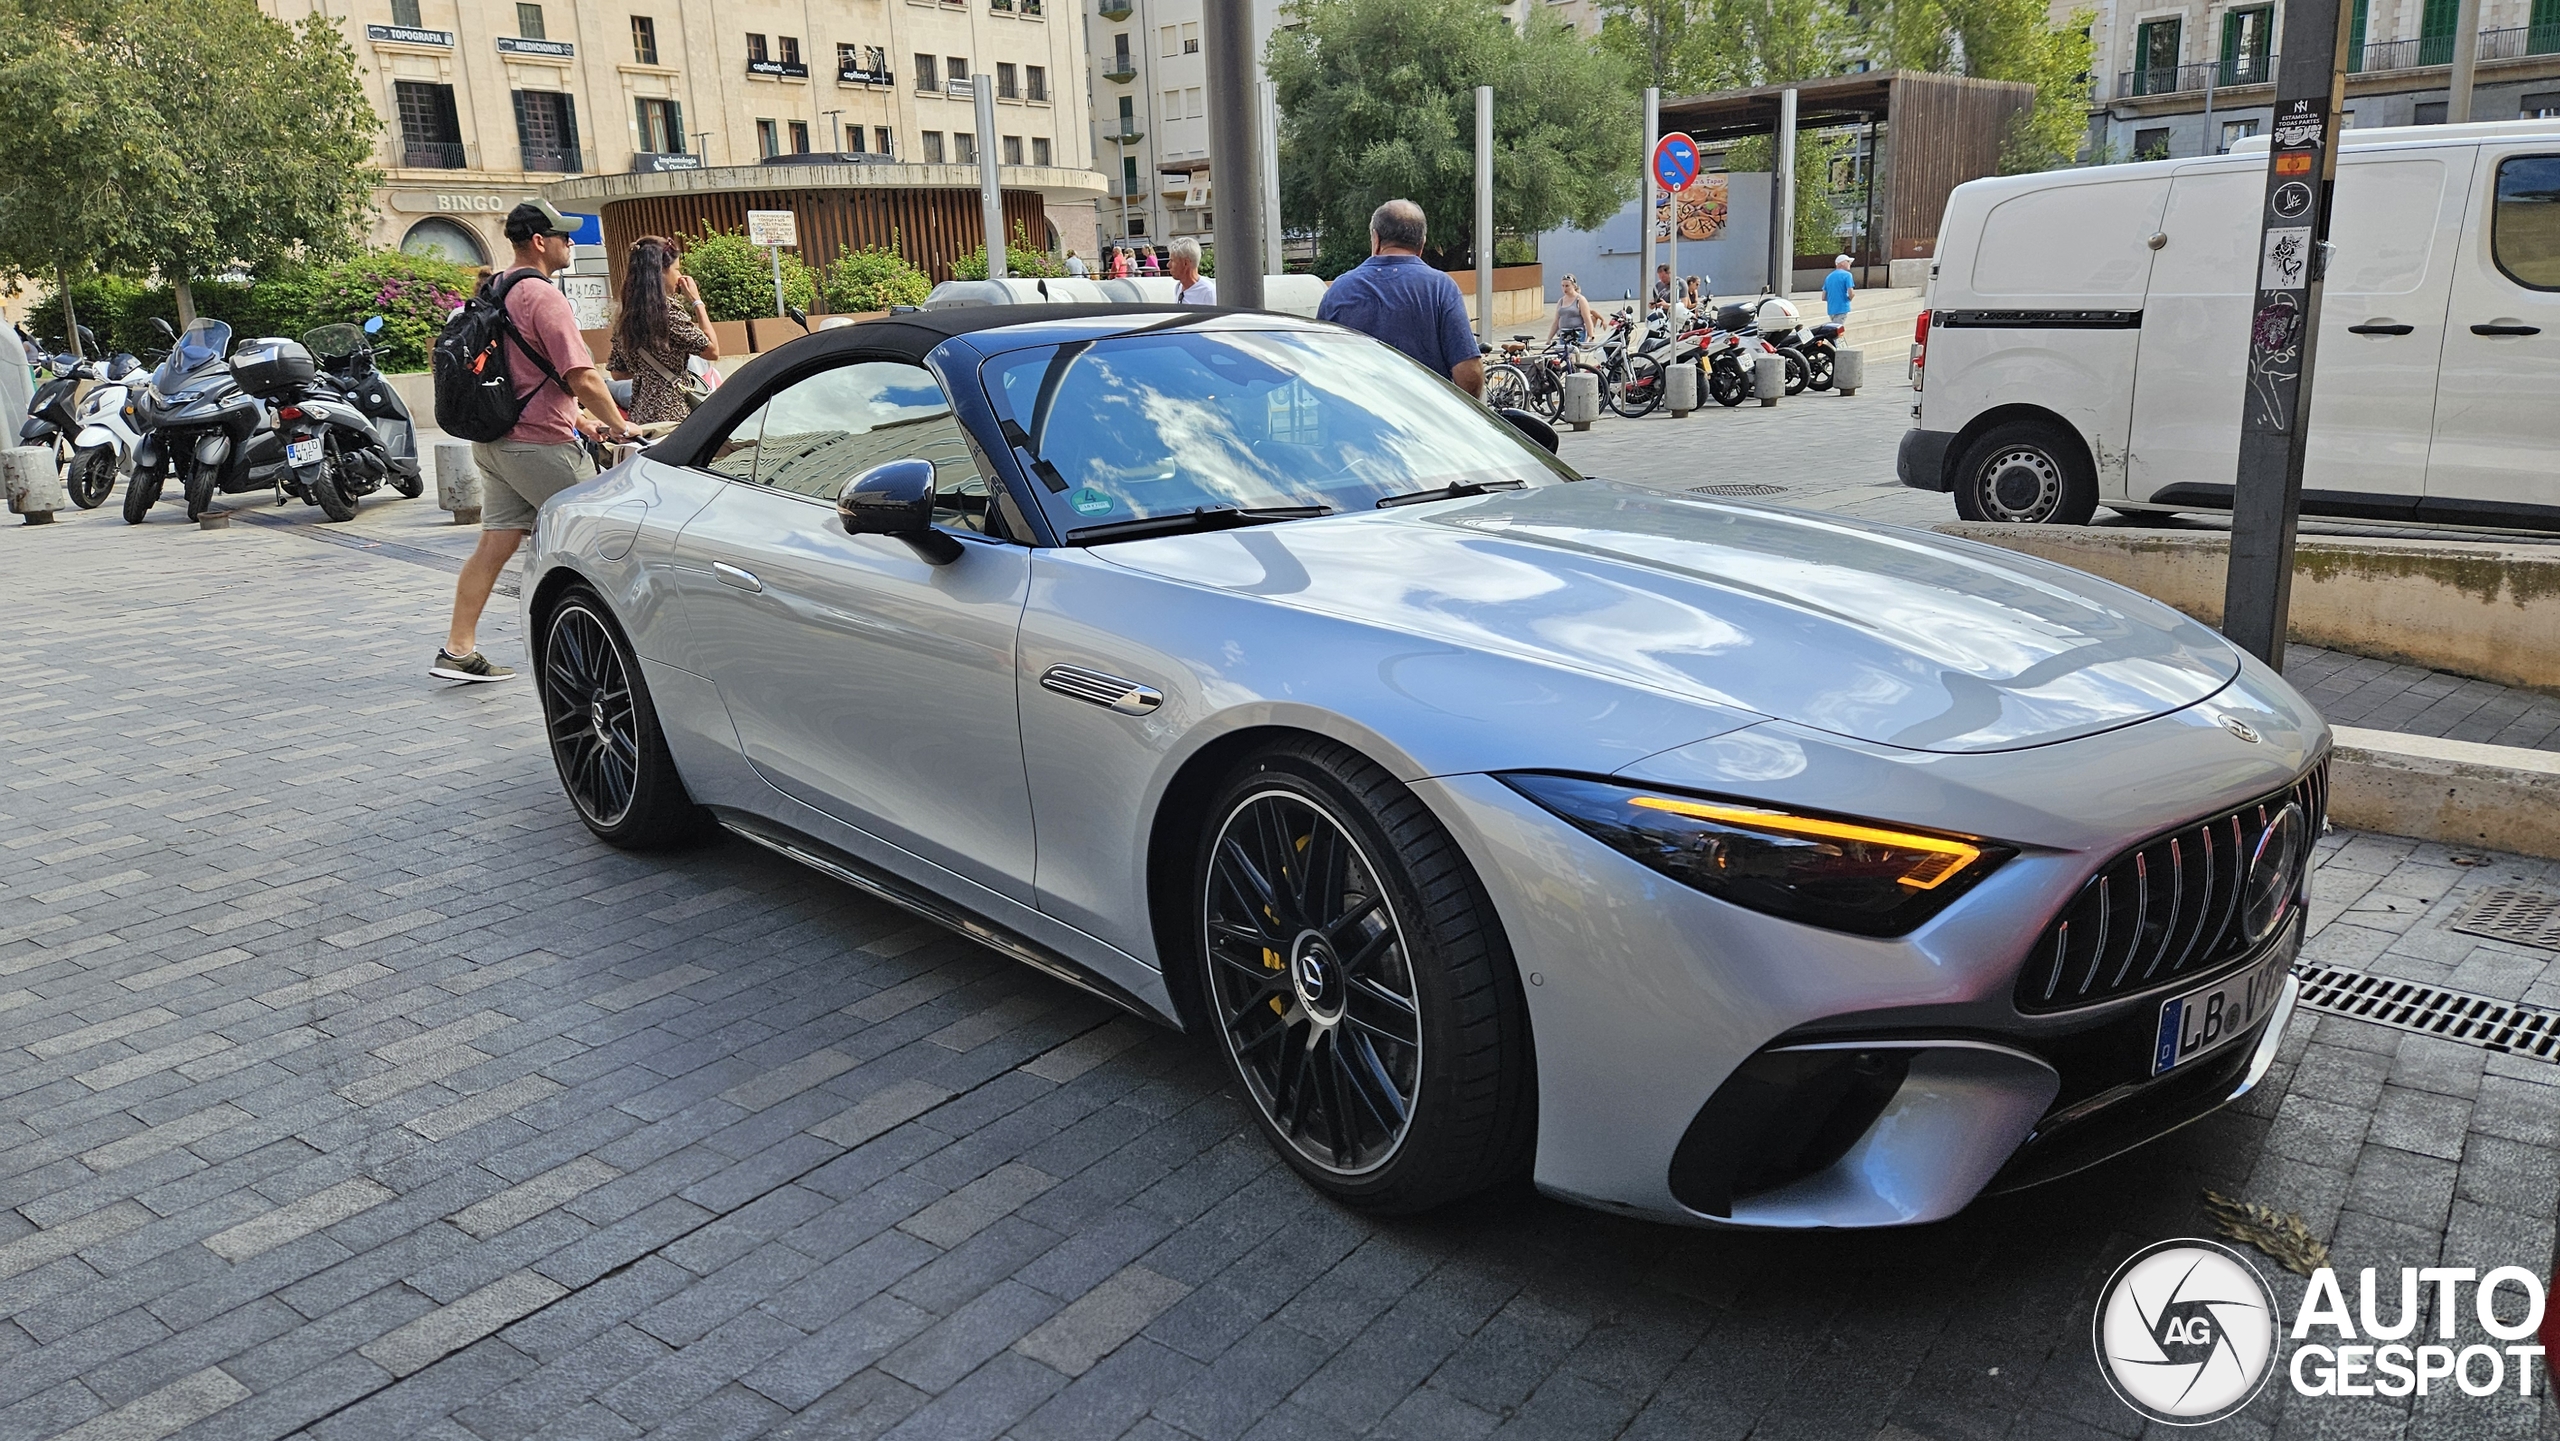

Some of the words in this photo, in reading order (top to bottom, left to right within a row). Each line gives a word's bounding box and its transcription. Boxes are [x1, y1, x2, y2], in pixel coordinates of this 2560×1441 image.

[390, 29, 443, 43] TOPOGRAFIA
[515, 41, 562, 53] MEDICIONES
[2281, 113, 2309, 121] ESTAMOS
[2298, 118, 2320, 126] PARTES
[437, 195, 503, 211] BINGO
[1085, 490, 1096, 502] 4
[2179, 990, 2225, 1057] LB
[2162, 1044, 2170, 1060] D
